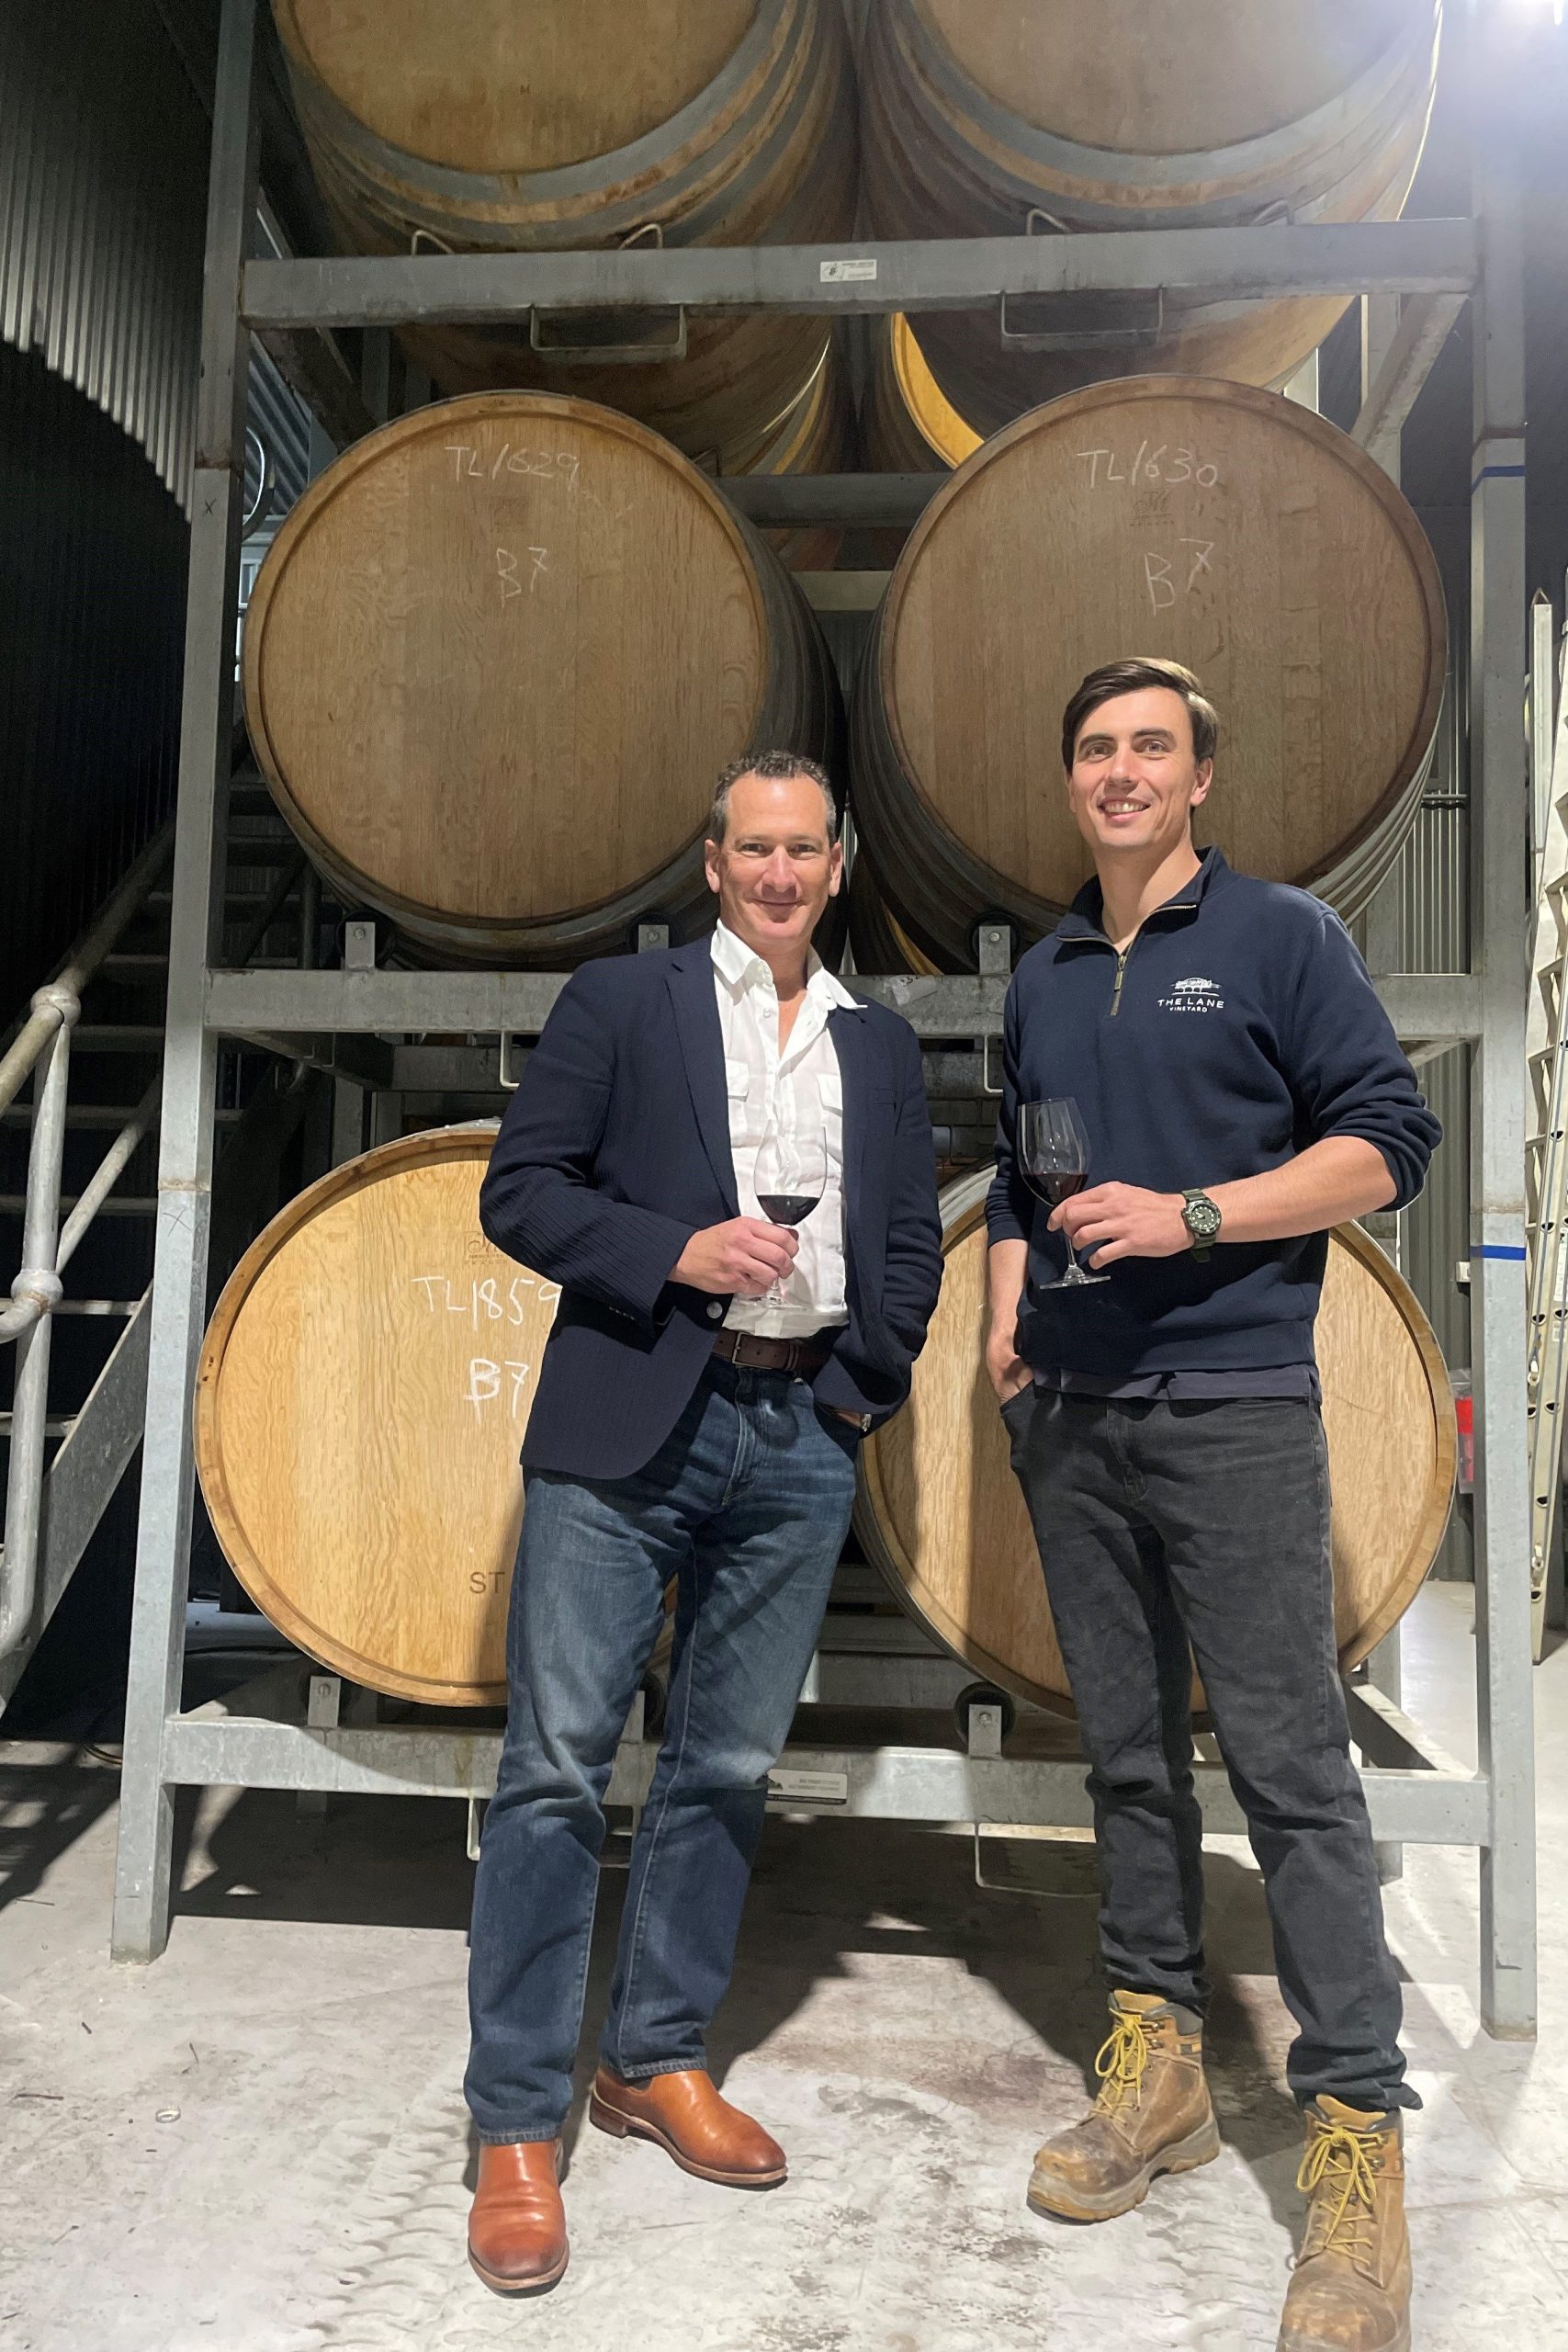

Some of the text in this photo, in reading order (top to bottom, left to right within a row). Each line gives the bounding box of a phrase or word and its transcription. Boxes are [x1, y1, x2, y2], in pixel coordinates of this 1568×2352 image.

[496, 547, 548, 609] B7
[1145, 537, 1215, 616] B7
[1157, 997, 1225, 1009] THE LANE
[463, 1357, 530, 1424] B7
[469, 1571, 505, 1594] ST
